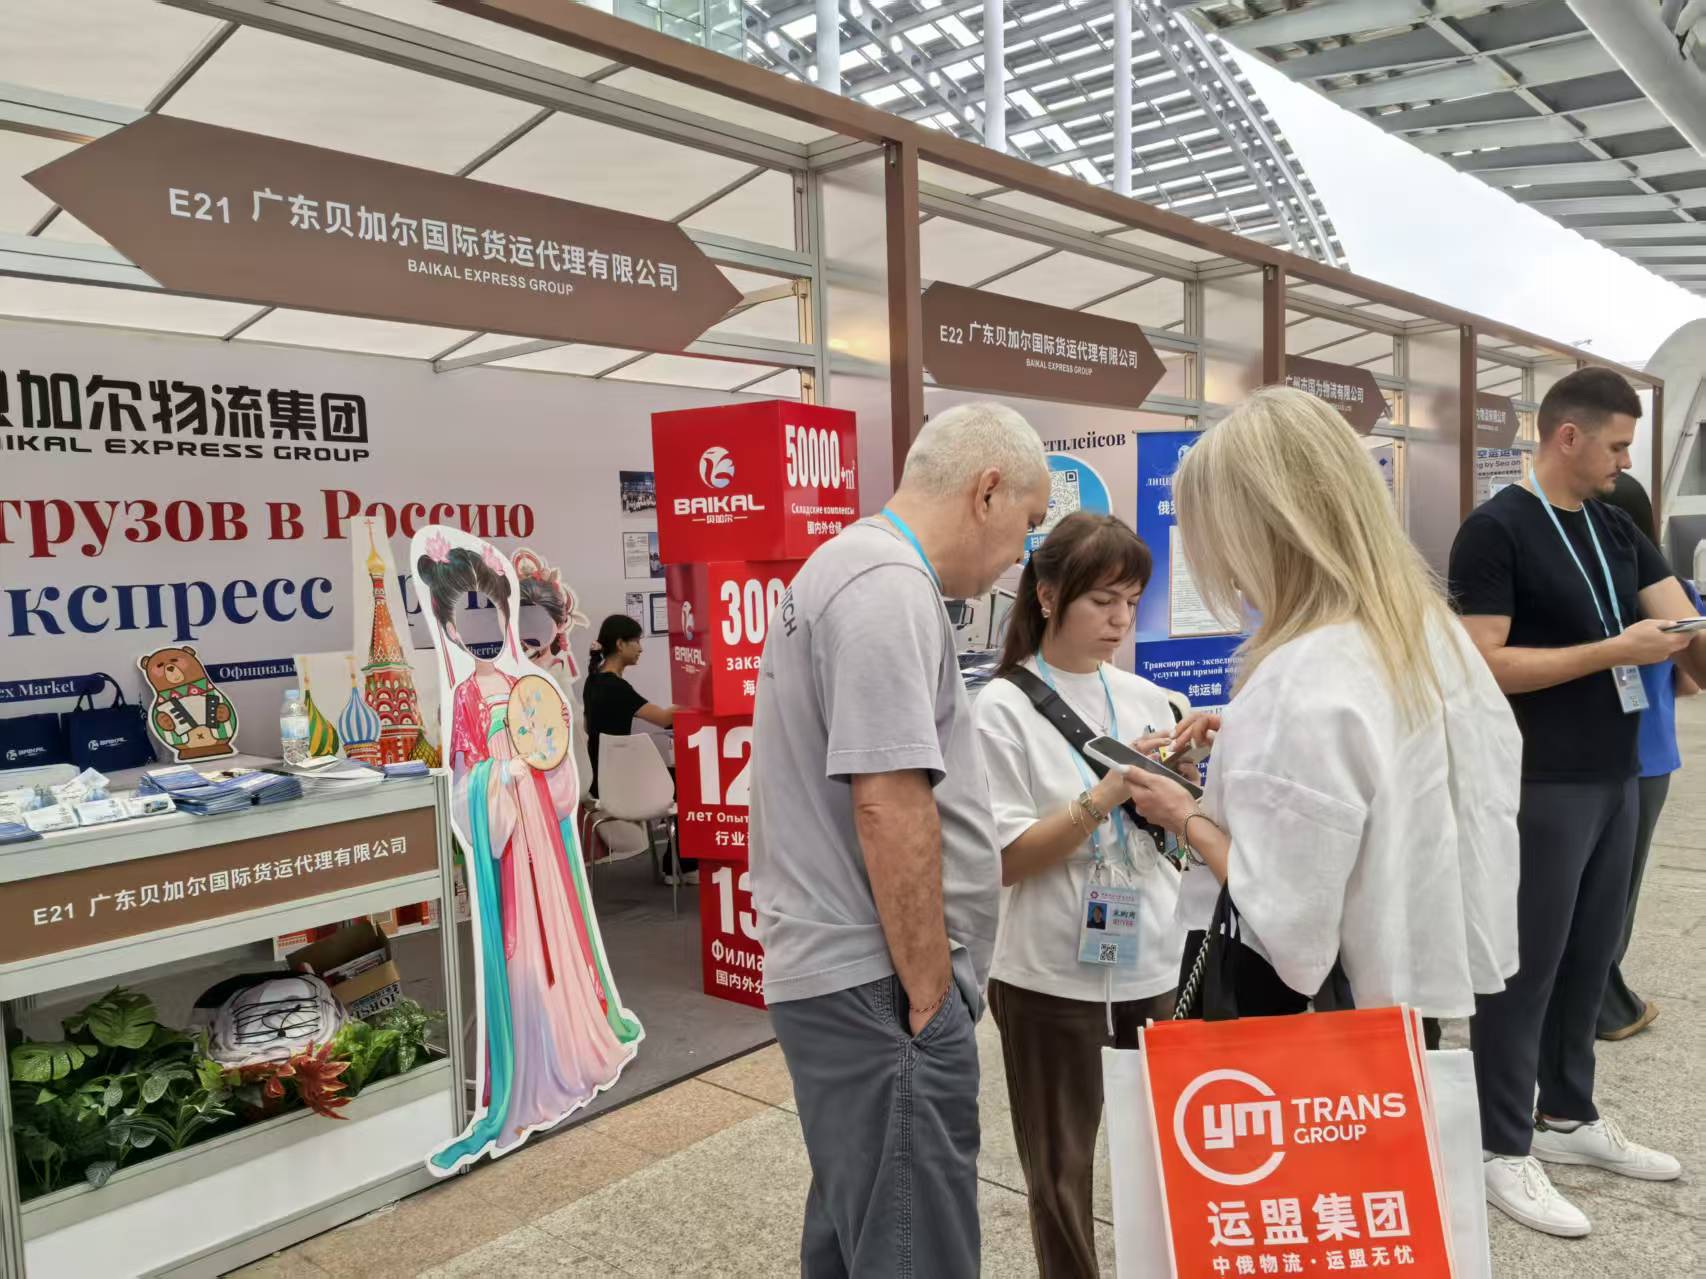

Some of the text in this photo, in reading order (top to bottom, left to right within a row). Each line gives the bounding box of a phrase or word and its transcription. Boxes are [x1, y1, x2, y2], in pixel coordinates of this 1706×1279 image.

[169, 187, 679, 292] E21 广东贝加尔国际货运代理有限公司
[407, 259, 574, 296] BAIKAL EXPRESS GROUP
[940, 320, 1138, 369] E22 广东贝加尔国际货运代理有限公司
[1047, 361, 1073, 374] EXPRESS
[0, 369, 369, 444] 加尔物流集团
[0, 434, 370, 462] IKAL EXPRESS GROUP
[673, 494, 765, 515] BAIKAL
[265, 501, 305, 541] в
[674, 646, 706, 666] BAIKAL
[20, 680, 75, 697] Market
[1188, 683, 1222, 697] 纯运输
[686, 811, 751, 823] лет Опыт
[715, 831, 751, 846] 行业
[33, 836, 408, 927] E21 广东贝加尔国际货运代理有限公司
[1291, 1092, 1407, 1124] TRANS
[1294, 1124, 1367, 1145] GROUP
[1206, 1190, 1411, 1248] 运盟集团
